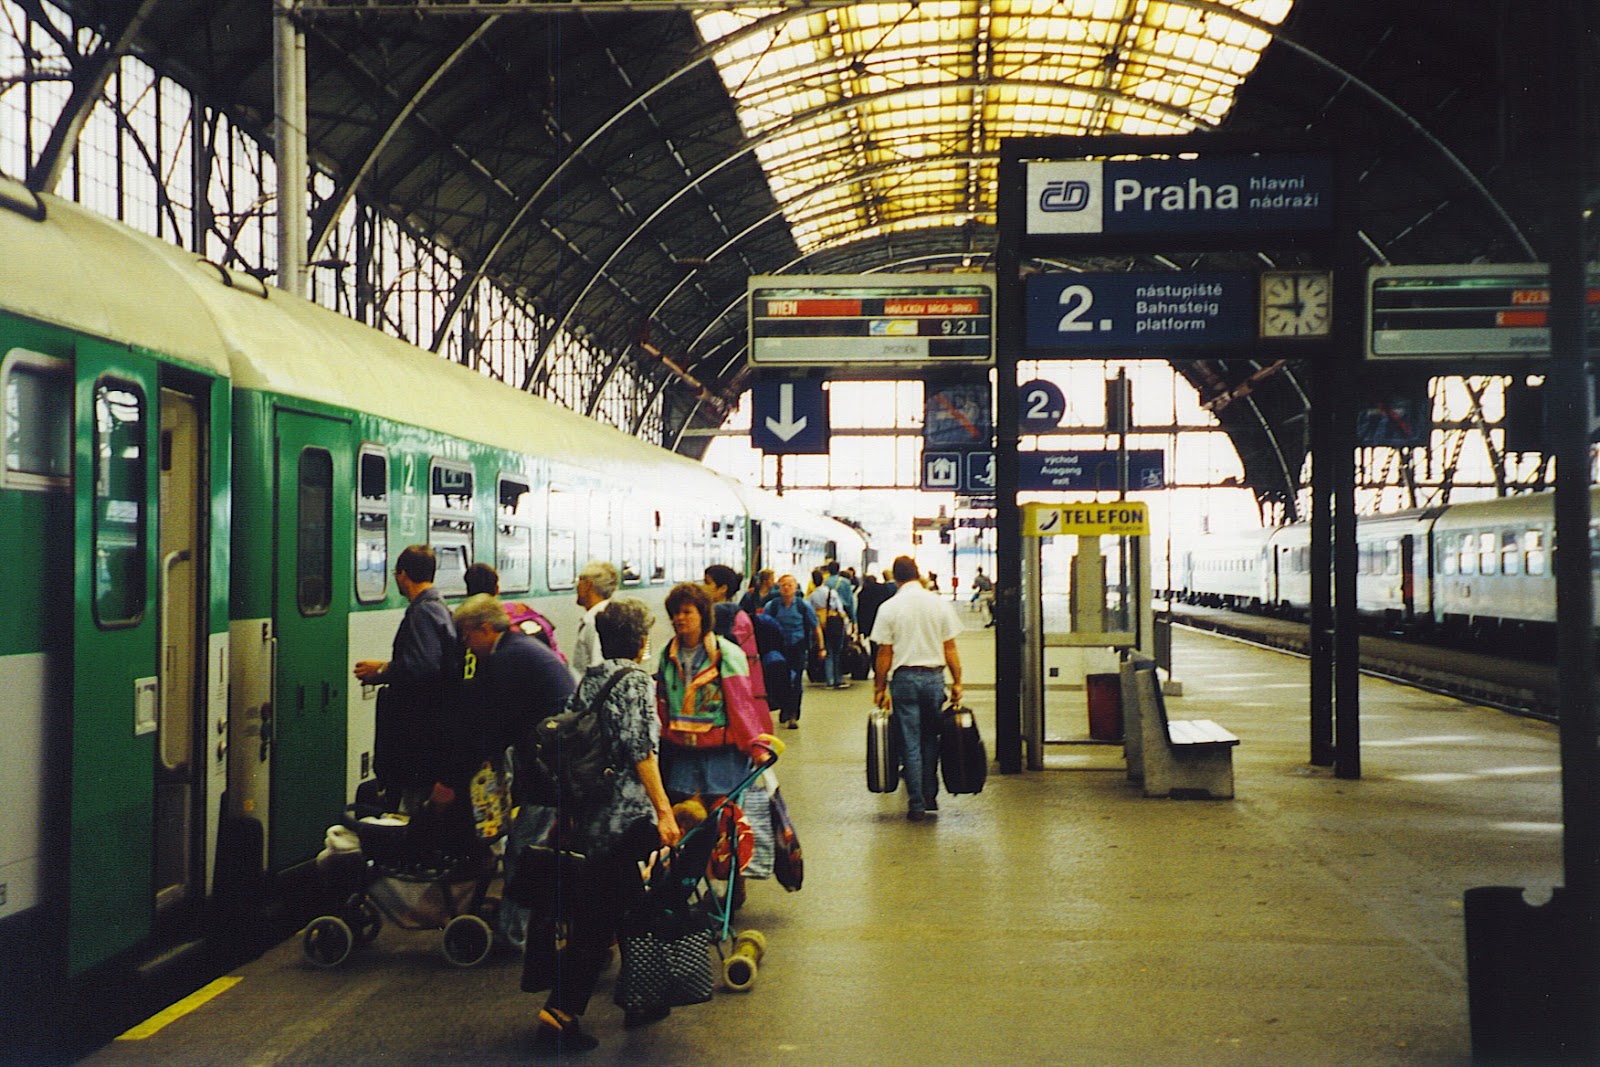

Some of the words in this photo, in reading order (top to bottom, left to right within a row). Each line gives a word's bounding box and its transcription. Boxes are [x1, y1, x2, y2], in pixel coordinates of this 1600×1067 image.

[1250, 175, 1305, 190] hlavní
[1114, 178, 1240, 211] Praha
[1250, 193, 1319, 208] nádraží
[1136, 284, 1222, 299] nástupiště
[767, 301, 798, 316] WIEN
[1058, 285, 1112, 332] 2.
[1136, 301, 1219, 316] Bahnsteig
[1136, 318, 1206, 333] platform
[1027, 390, 1060, 419] 2.
[1063, 509, 1143, 525] TELEFON
